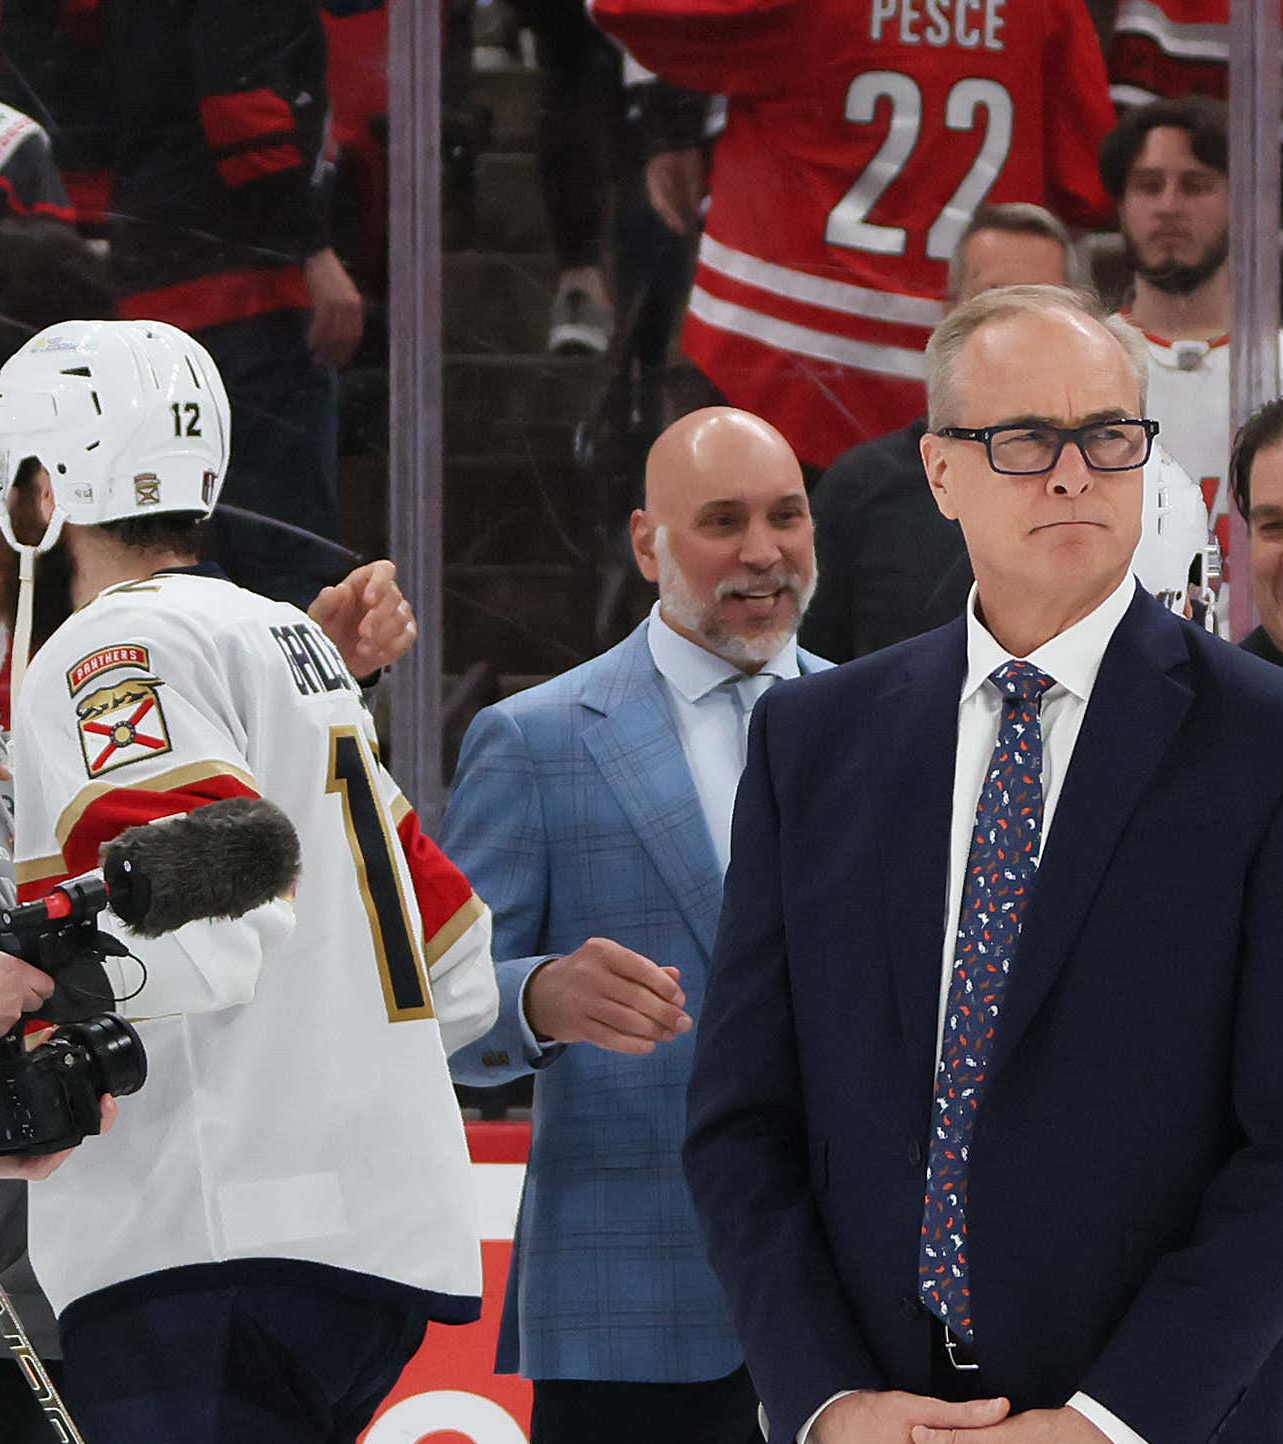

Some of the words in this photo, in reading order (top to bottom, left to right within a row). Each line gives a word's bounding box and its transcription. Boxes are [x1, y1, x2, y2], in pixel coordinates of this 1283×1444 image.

[870, 0, 1006, 49] PESCE
[824, 69, 1014, 260] 22
[170, 402, 202, 437] 12
[76, 649, 138, 681] PANTHERS
[325, 724, 434, 1024] 1
